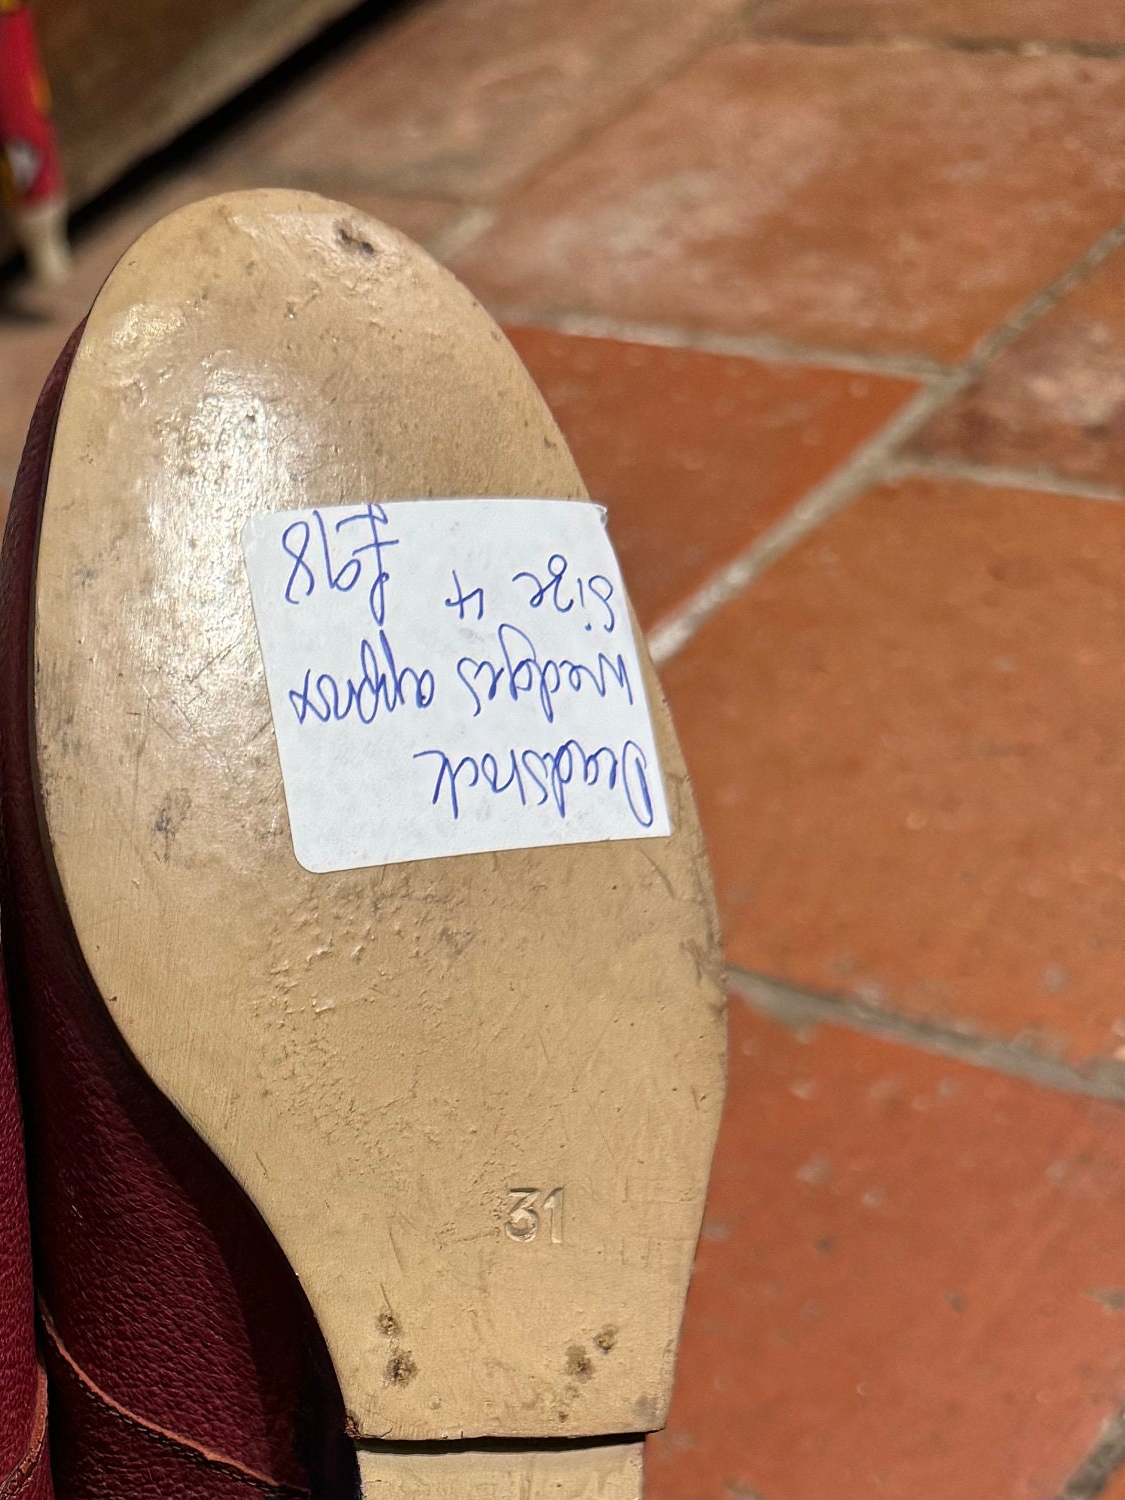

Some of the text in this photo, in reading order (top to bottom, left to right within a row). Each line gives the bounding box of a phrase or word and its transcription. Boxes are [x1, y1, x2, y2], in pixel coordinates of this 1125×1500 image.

[281, 504, 400, 627] £98
[445, 570, 484, 620] 4
[288, 629, 435, 724] approx
[504, 1186, 565, 1244] 31
